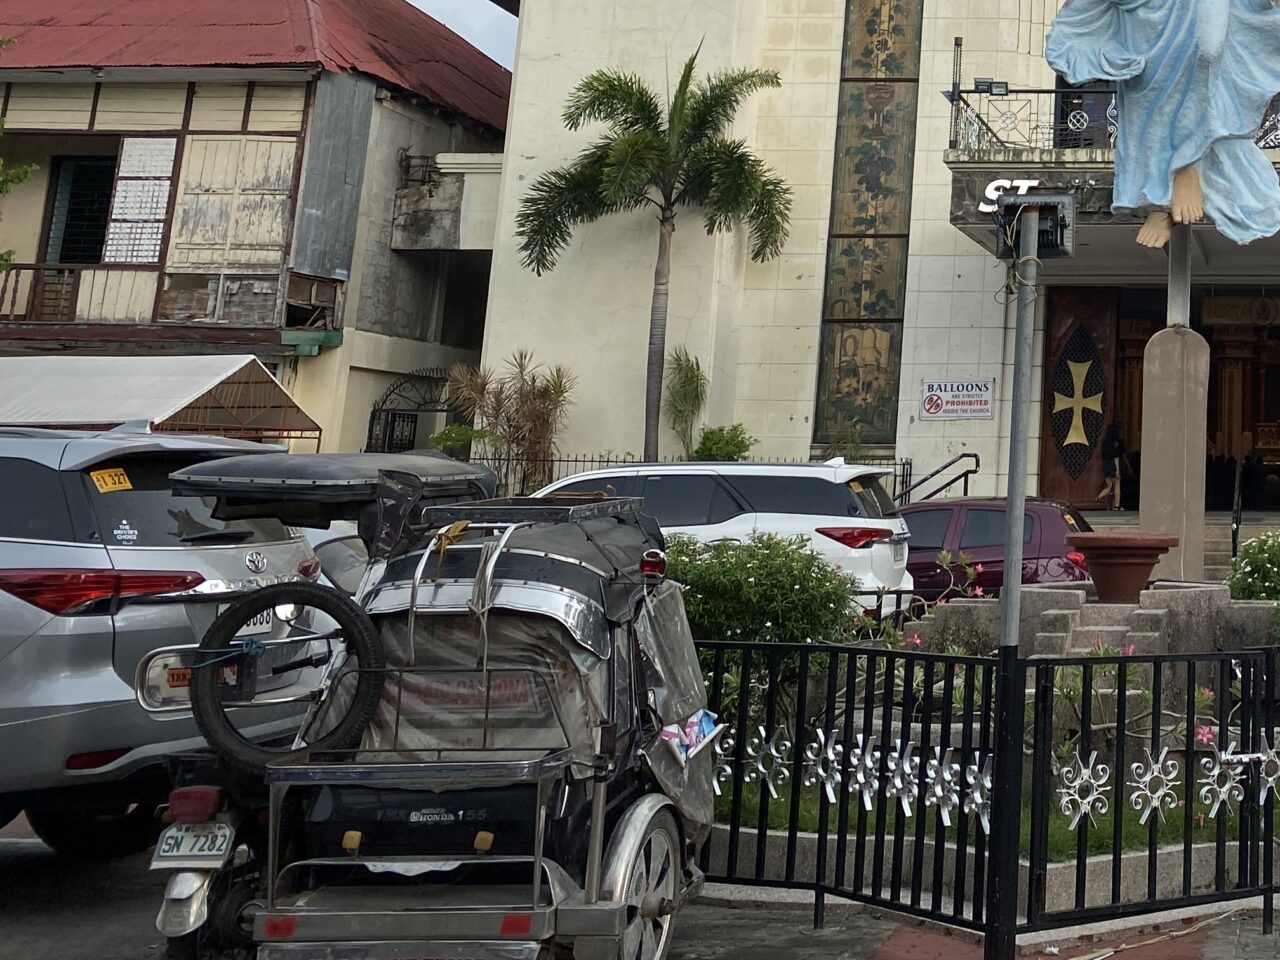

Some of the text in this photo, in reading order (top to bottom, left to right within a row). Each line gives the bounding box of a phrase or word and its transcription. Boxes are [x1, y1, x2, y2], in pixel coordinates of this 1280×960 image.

[927, 383, 989, 393] BALLOONS
[108, 473, 128, 486] 327
[420, 813, 455, 821] HONDA
[162, 834, 227, 853] SN 7282
